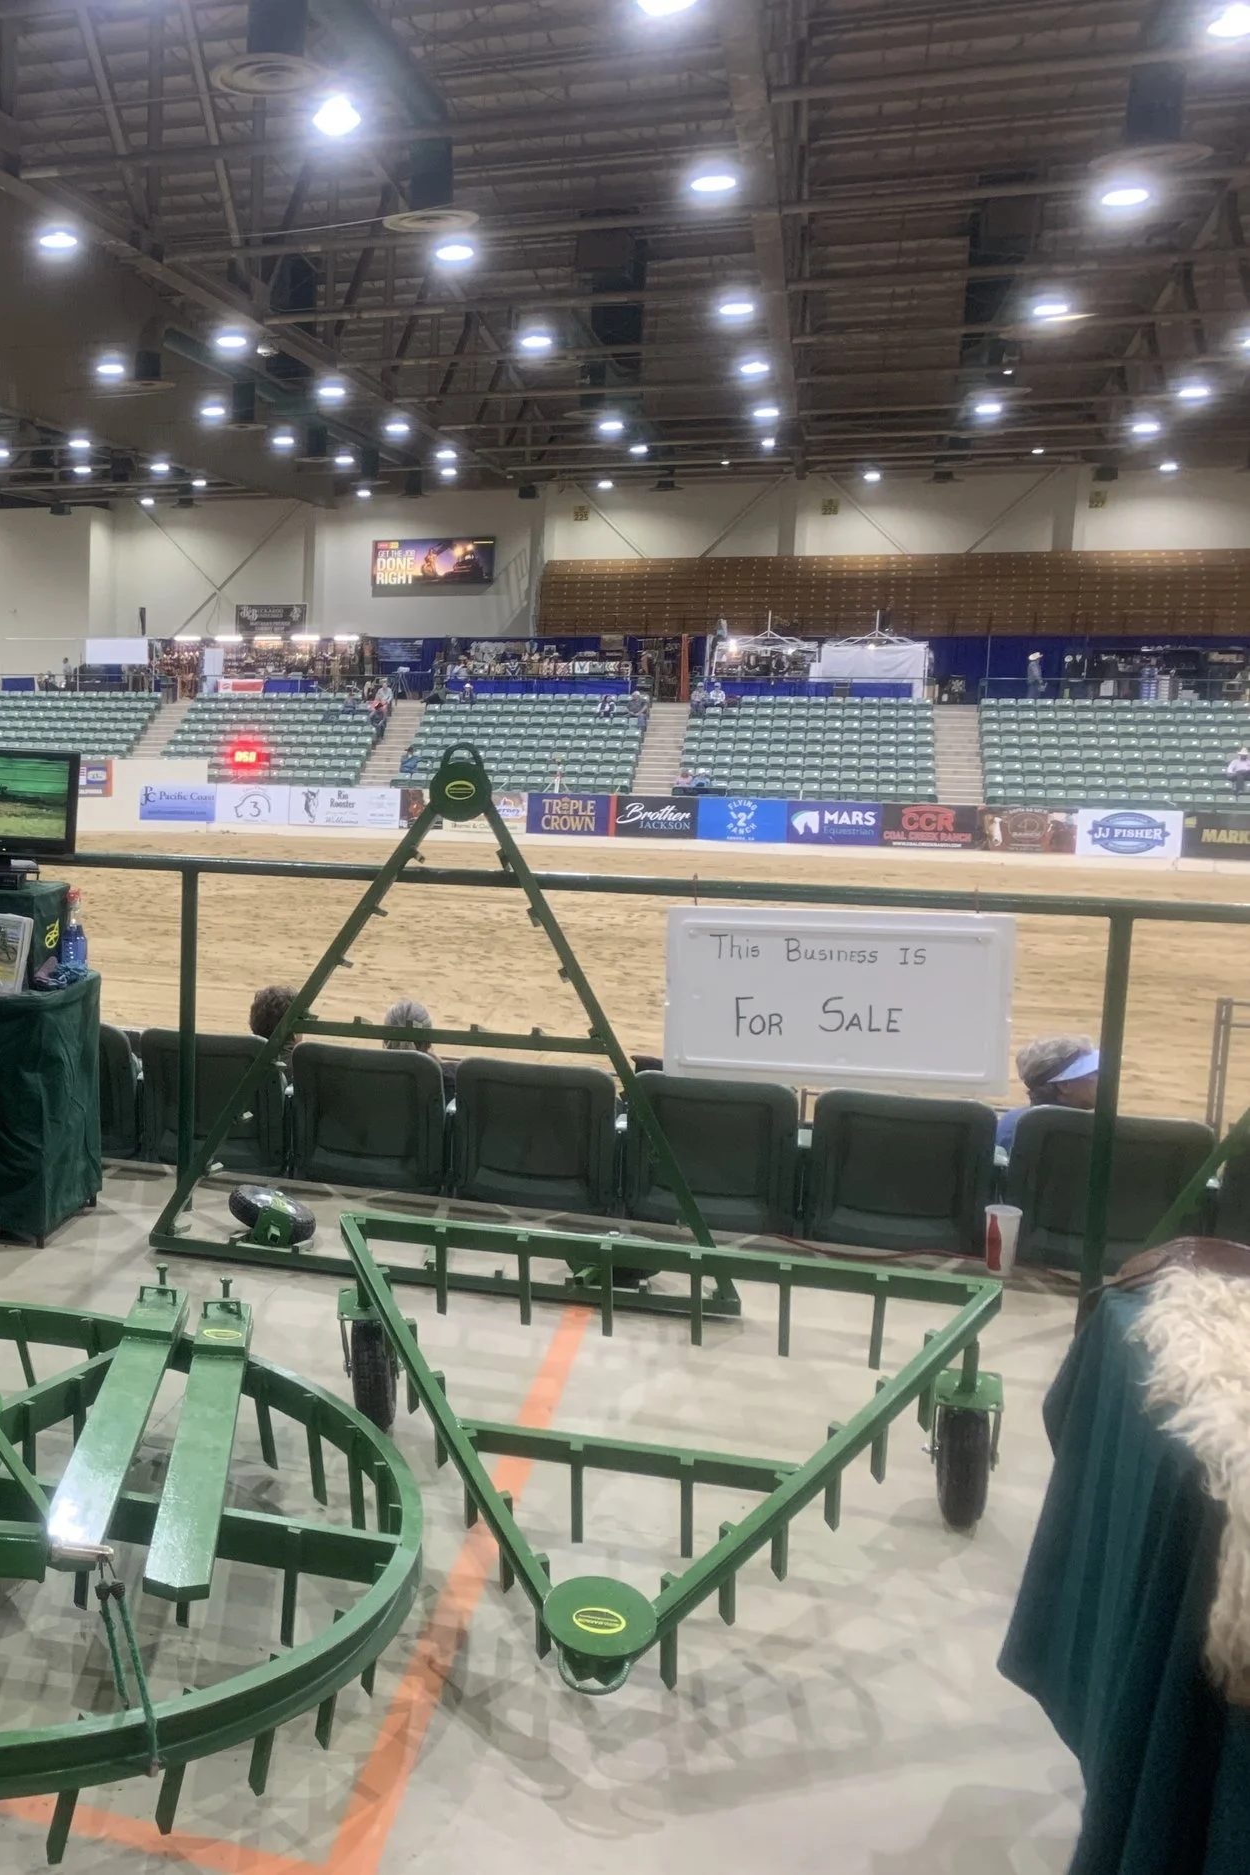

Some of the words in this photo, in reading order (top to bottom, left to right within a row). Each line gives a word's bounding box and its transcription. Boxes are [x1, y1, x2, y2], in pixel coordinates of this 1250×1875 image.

[377, 557, 415, 571] DONE
[376, 571, 414, 584] RIGHT
[159, 790, 187, 801] Pacific
[190, 792, 215, 801] Coast
[330, 798, 356, 808] Rooster
[727, 799, 758, 811] FLYING
[616, 802, 691, 824] Brother
[824, 810, 877, 826] MARS
[541, 815, 595, 831] CROWN
[638, 821, 691, 830] JACKSON
[901, 810, 956, 832] CCR
[726, 822, 758, 835] RANCH
[823, 827, 875, 836] Equestrian
[1094, 828, 1110, 838] JJ
[1113, 828, 1163, 840] FISHER
[709, 933, 761, 960] This
[818, 996, 903, 1034] SALE
